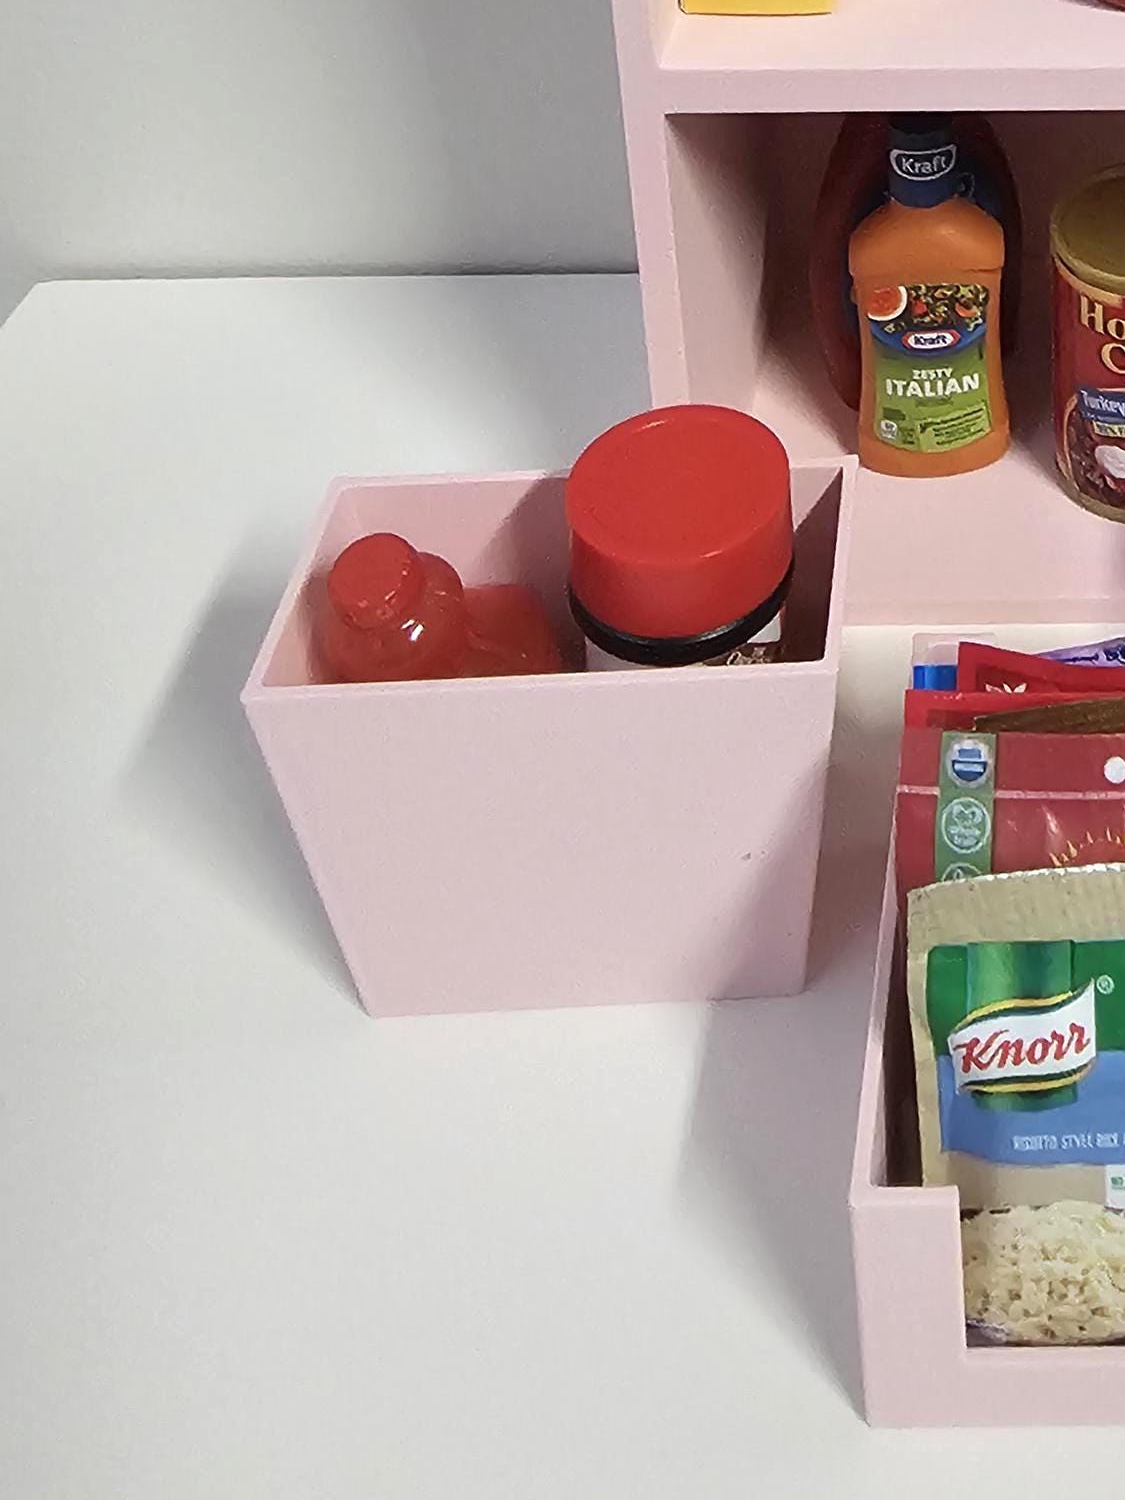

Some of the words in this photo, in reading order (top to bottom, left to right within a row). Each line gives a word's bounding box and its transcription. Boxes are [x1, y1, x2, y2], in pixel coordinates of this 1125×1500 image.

[901, 155, 948, 175] Kraft
[913, 334, 948, 346] Kraft
[912, 367, 954, 381] ZESTY
[885, 373, 980, 398] ITALIAN
[1080, 389, 1125, 417] Turkey
[954, 1022, 1091, 1074] Knorr
